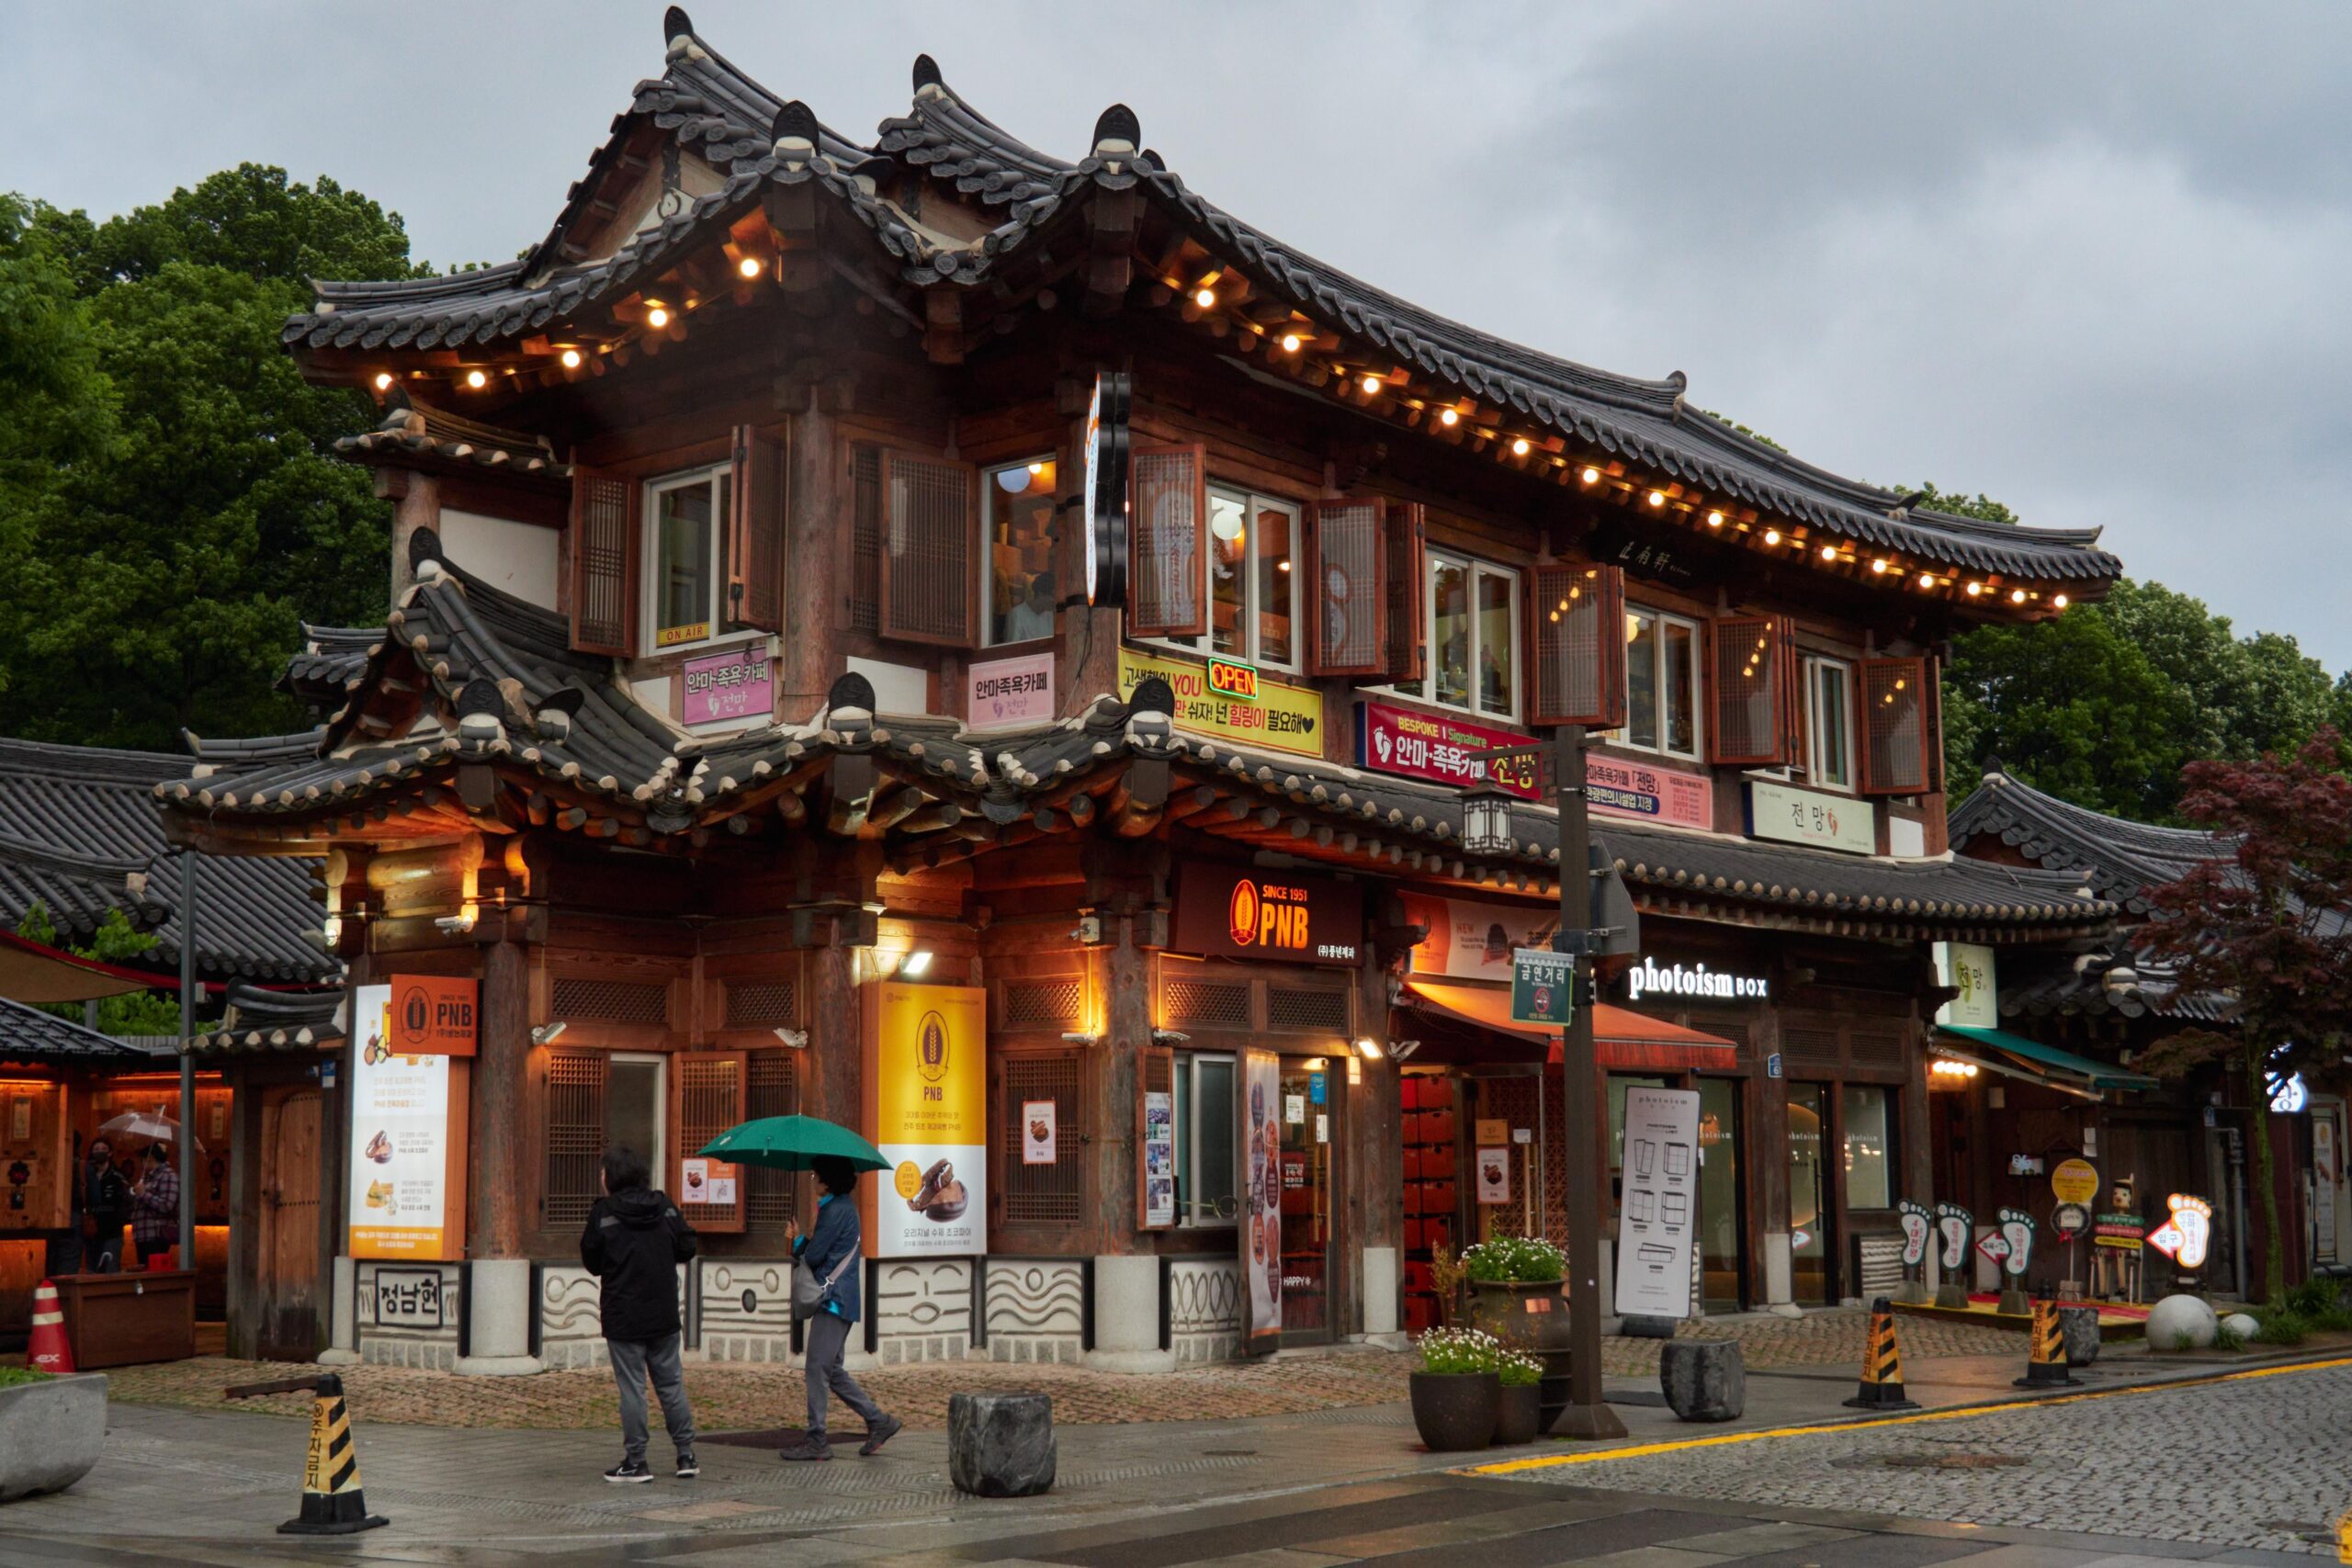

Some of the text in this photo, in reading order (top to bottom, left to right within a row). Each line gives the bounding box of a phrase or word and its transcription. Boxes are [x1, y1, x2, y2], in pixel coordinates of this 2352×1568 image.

[666, 626, 703, 641] ON AIR
[976, 671, 1047, 700] 안마족욕카페
[1173, 673, 1202, 697] YOU
[1212, 663, 1257, 695] OPEN
[721, 691, 748, 713] 전망
[1216, 703, 1227, 725] 넌
[1230, 705, 1265, 728] 힐링이
[1268, 710, 1301, 734] 필요해
[1397, 716, 1487, 748] BESPOKE Signature
[1792, 801, 1825, 831] 전망
[1262, 885, 1307, 902] SINCE 1951
[1260, 902, 1308, 949] PNB
[1456, 922, 1474, 934] NEW
[1521, 964, 1565, 984] 금연거리
[1630, 956, 1767, 998] photoism BOX
[437, 1003, 472, 1026] PNB
[923, 1086, 943, 1101] PNB
[1639, 1096, 1688, 1105] photoism
[2158, 1234, 2177, 1245] 입구
[1283, 1276, 1305, 1286] HAPPY
[381, 1279, 437, 1314] 정남헌
[306, 1418, 322, 1489] 주차금지
